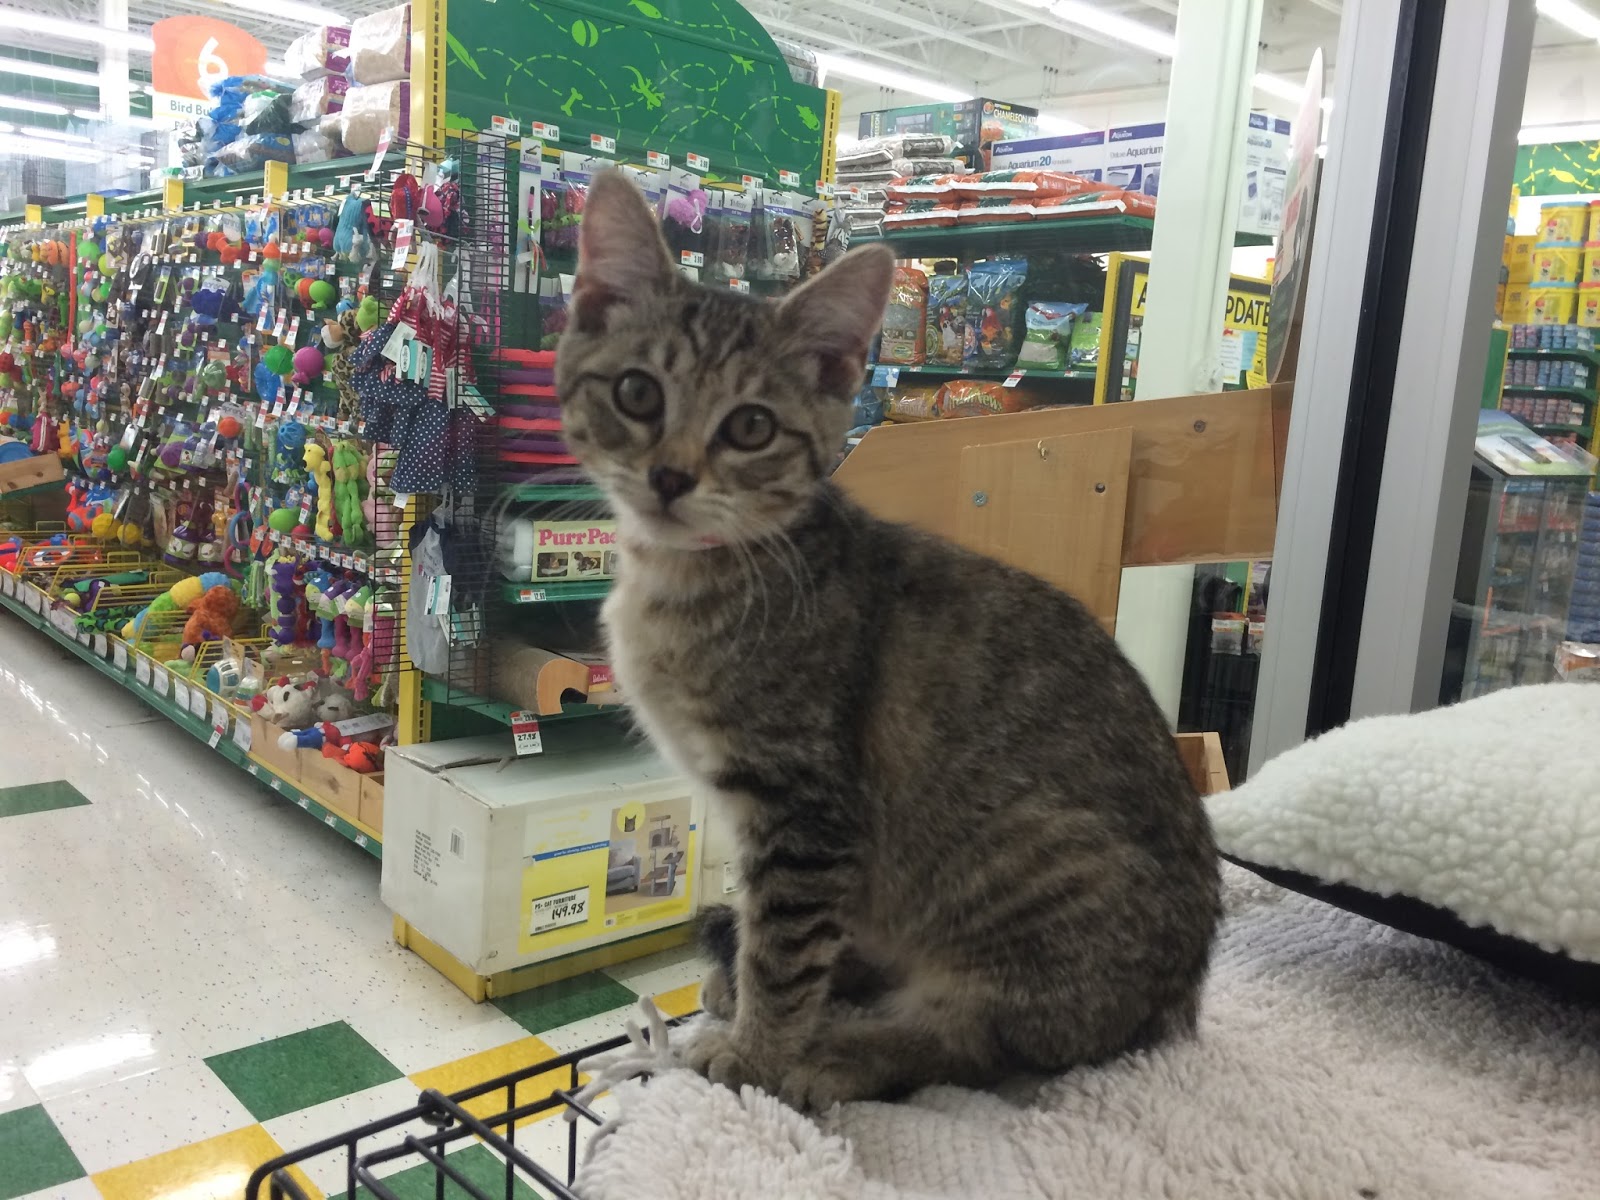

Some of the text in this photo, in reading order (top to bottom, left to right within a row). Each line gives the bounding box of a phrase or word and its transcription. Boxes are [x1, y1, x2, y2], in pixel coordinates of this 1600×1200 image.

[198, 37, 228, 84] 6
[170, 99, 193, 114] Bird
[993, 108, 1027, 123] CHAMELEON
[1126, 145, 1163, 157] Aquarium
[1008, 159, 1040, 171] Aquarium
[1040, 156, 1052, 167] 20
[1225, 295, 1270, 327] PDATE
[517, 732, 536, 742] 27.98
[552, 900, 585, 920] 149.98
